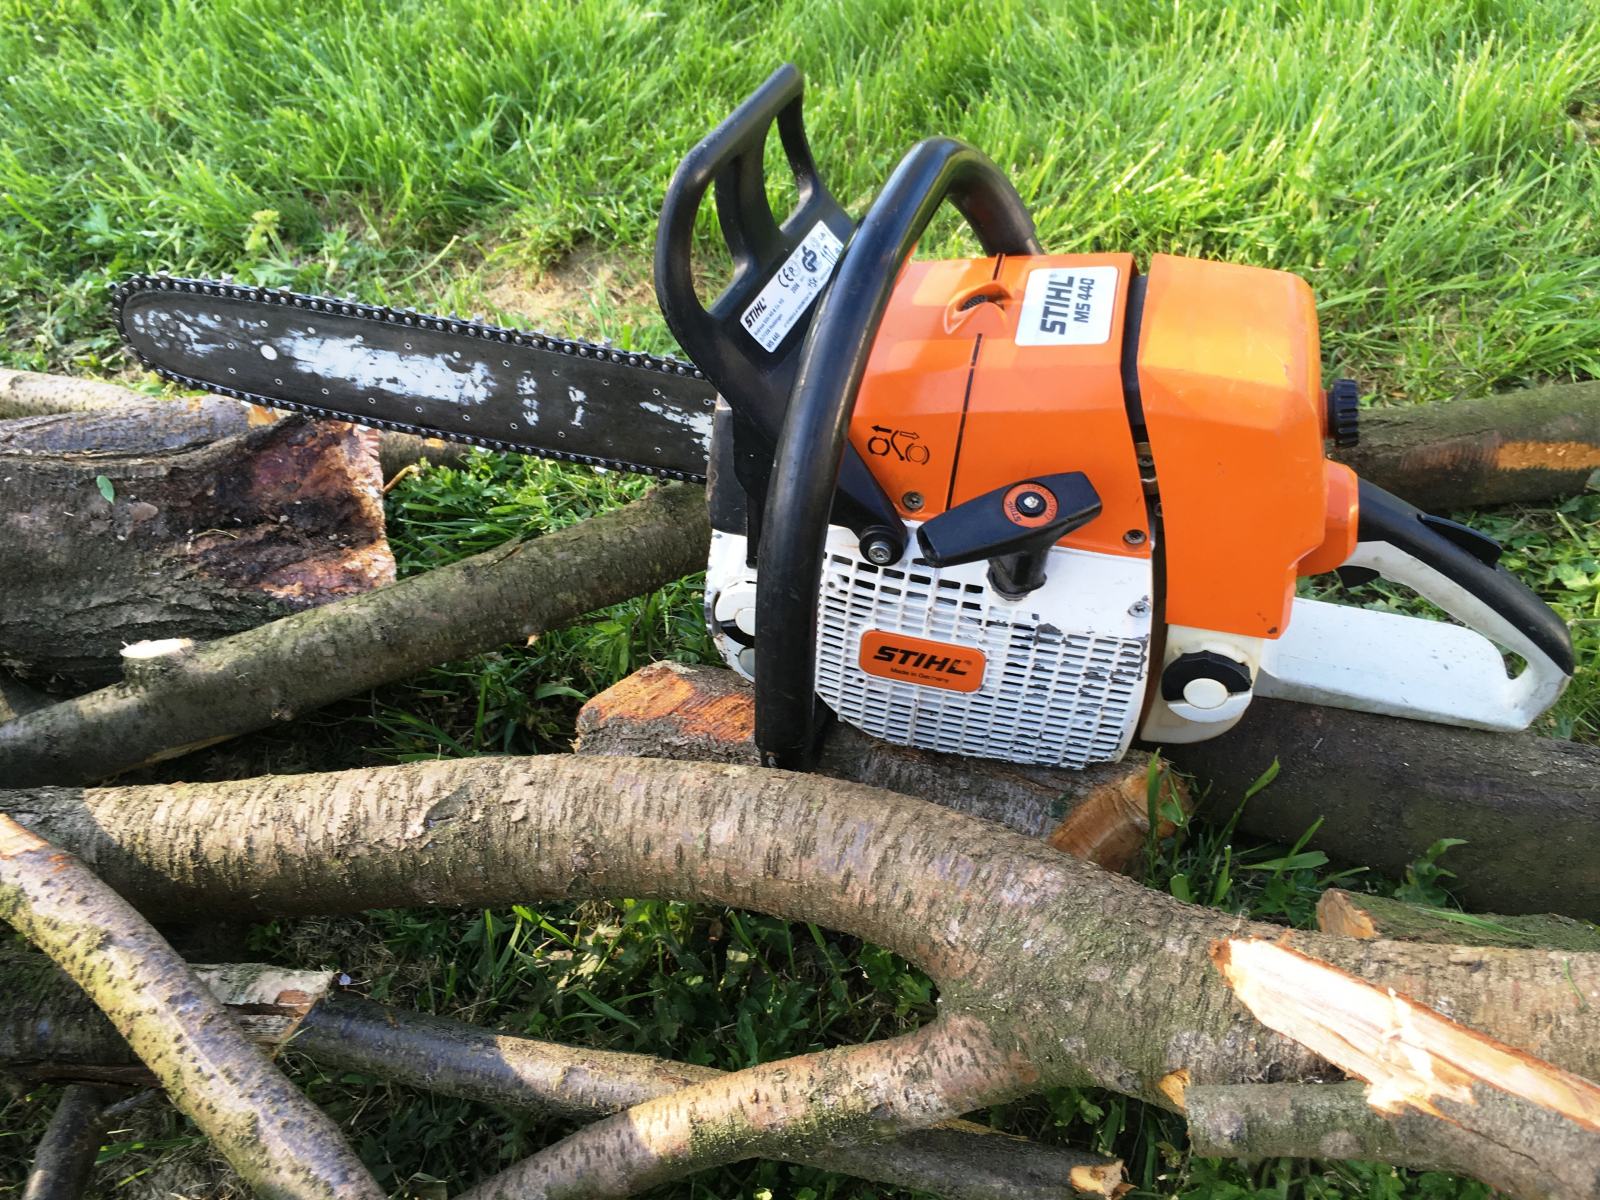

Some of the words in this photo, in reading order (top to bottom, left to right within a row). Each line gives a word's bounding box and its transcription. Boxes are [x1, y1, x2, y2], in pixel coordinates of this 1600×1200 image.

[1077, 278, 1095, 301] 440
[744, 300, 767, 328] STIHL
[1040, 276, 1075, 335] STIHL
[1073, 303, 1091, 323] MS
[1007, 500, 1022, 523] STIHL
[873, 646, 968, 676] STIHL
[890, 667, 910, 676] Made
